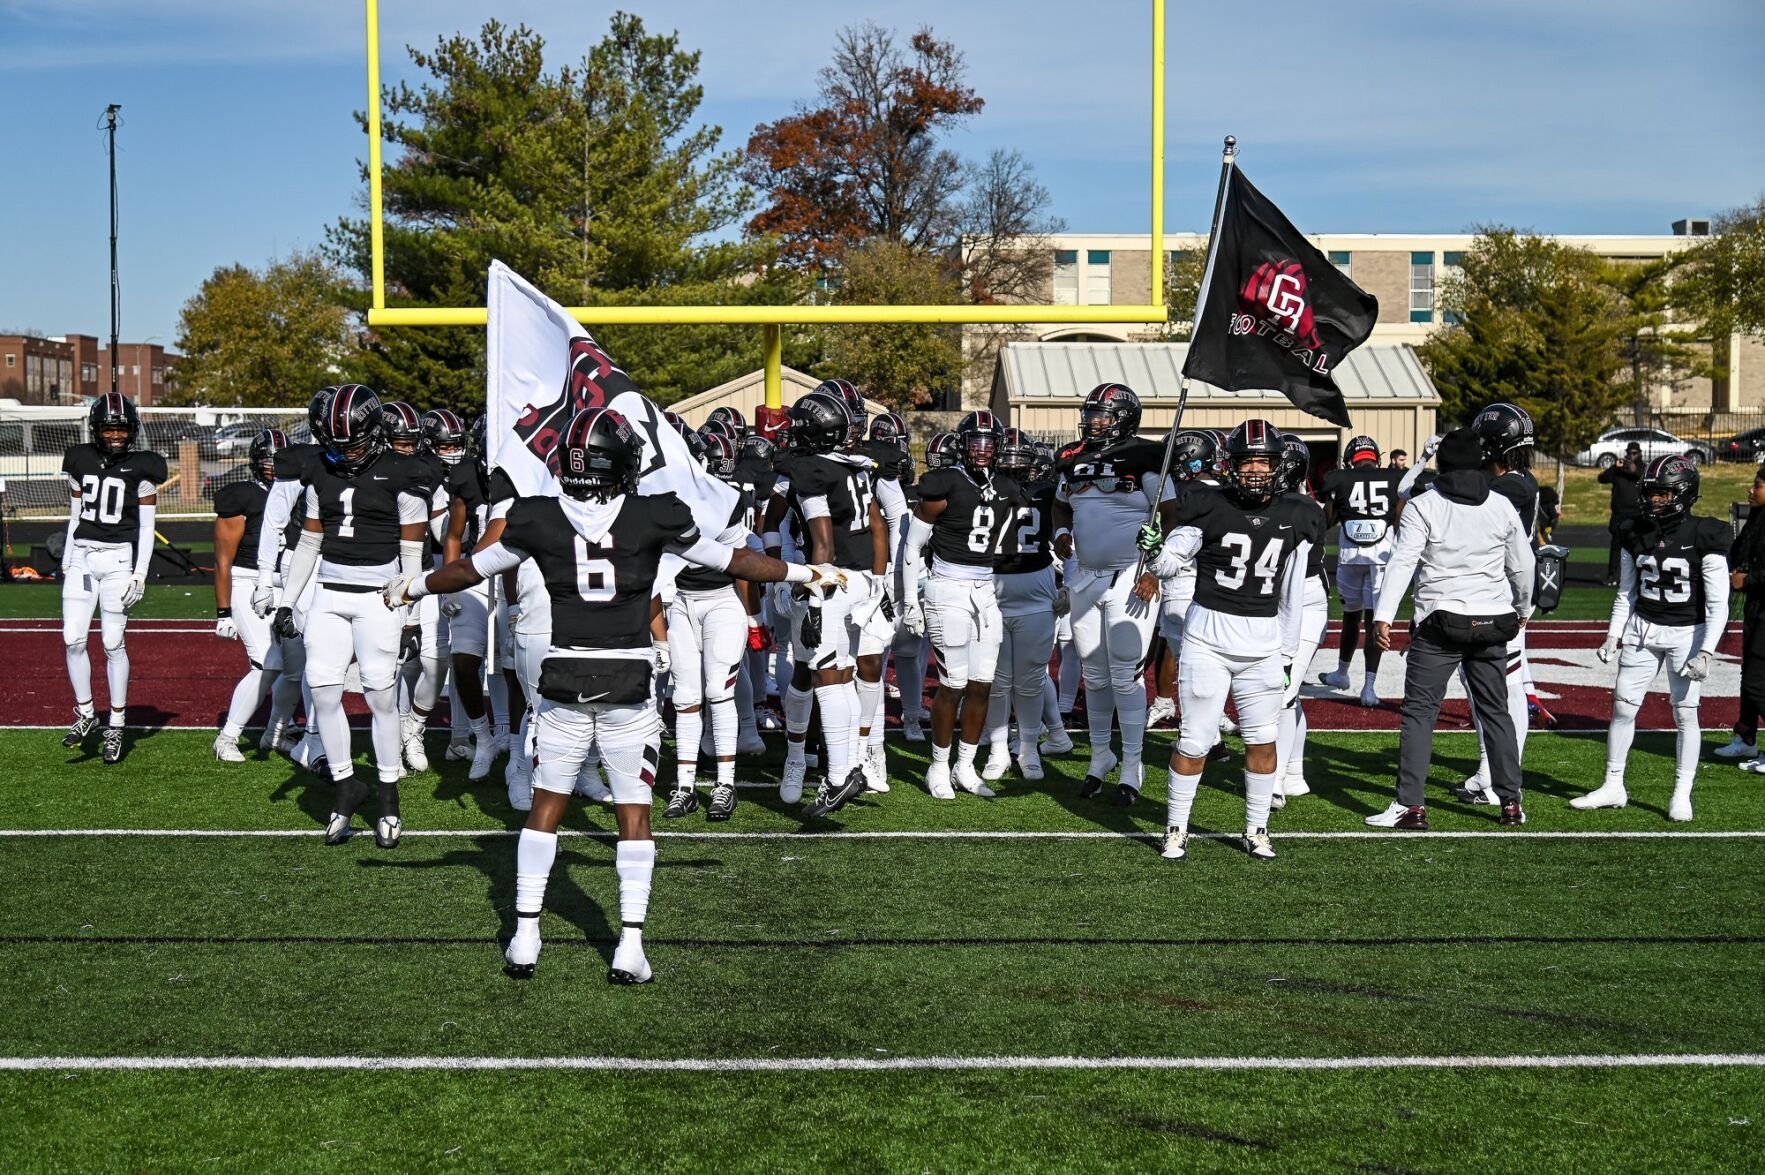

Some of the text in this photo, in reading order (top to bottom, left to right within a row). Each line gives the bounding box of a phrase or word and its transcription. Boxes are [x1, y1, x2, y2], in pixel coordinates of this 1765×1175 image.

[1228, 313, 1329, 375] FOOTBAL
[800, 399, 828, 423] RITTER
[570, 448, 584, 472] 6
[80, 475, 126, 524] 20
[338, 487, 355, 537] 1
[1348, 481, 1389, 516] 45
[574, 535, 617, 601] 6
[1214, 532, 1285, 595] 34
[1636, 554, 1692, 603] 23
